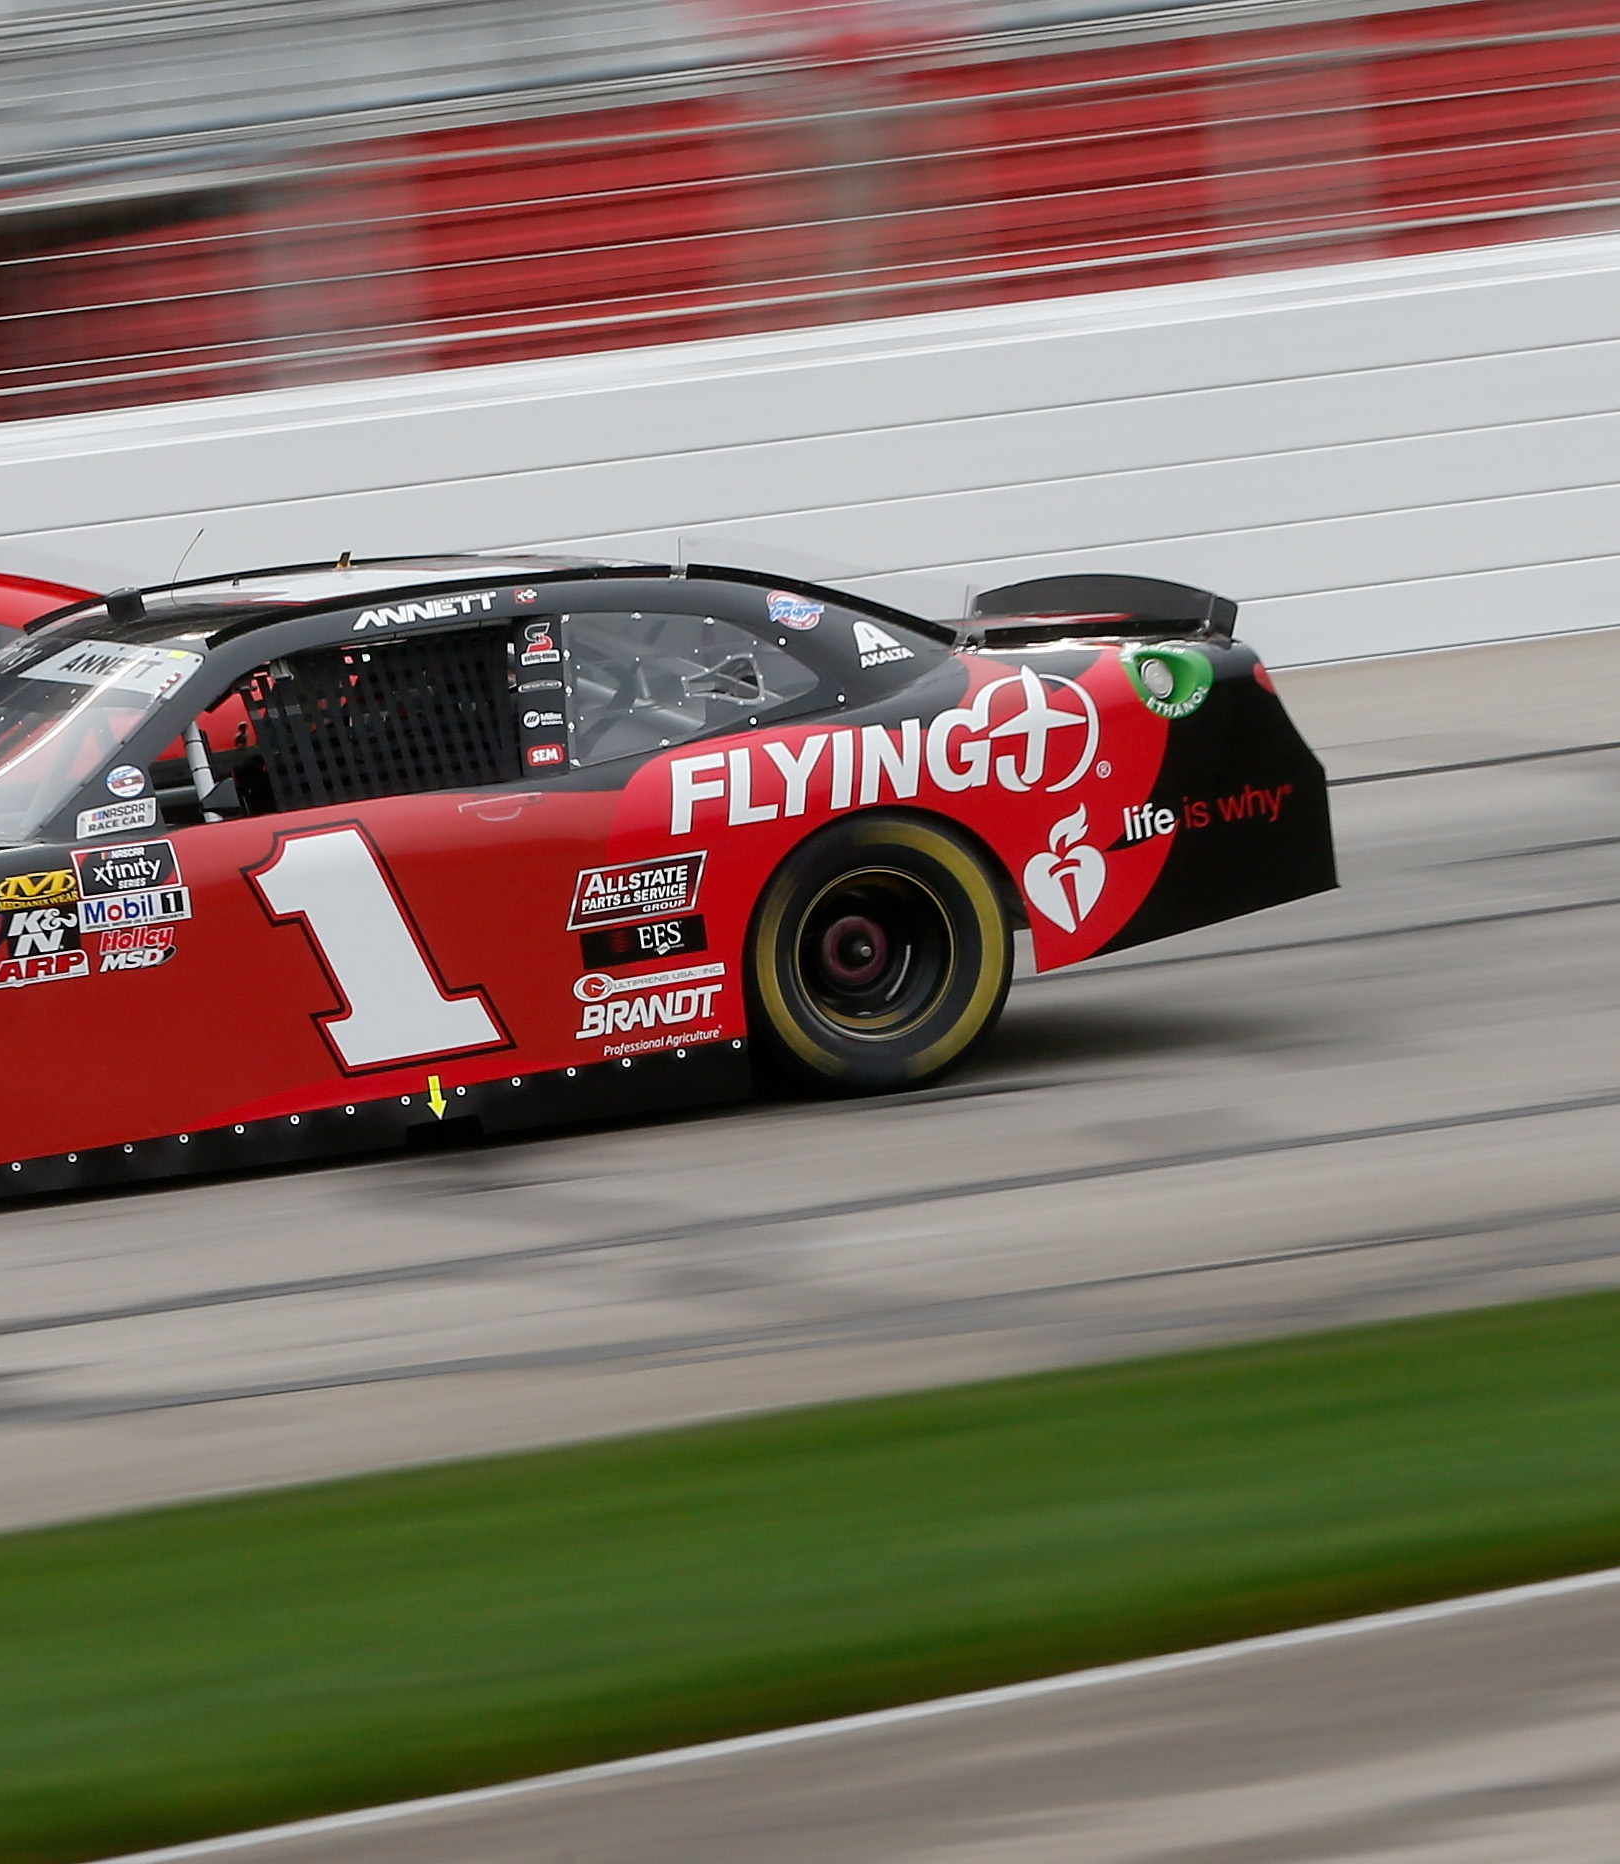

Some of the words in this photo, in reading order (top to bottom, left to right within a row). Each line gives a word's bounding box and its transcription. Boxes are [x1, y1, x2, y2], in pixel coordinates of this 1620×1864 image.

[353, 591, 497, 631] ANNETT
[59, 653, 163, 679] ANNET
[860, 646, 915, 669] AXALTA
[1146, 686, 1210, 717] ETHANOL
[532, 749, 559, 763] SEM
[670, 707, 990, 835] FLYING
[87, 820, 119, 832] RACE
[122, 814, 146, 826] CAR
[102, 802, 146, 819] NASCAR
[1123, 803, 1176, 841] life
[1183, 795, 1211, 829] is
[1217, 784, 1282, 822] why
[111, 847, 145, 859] NASCAR
[92, 857, 161, 886] xfinity
[118, 877, 147, 890] SERIES
[584, 864, 689, 898] ALLSTATE
[84, 894, 154, 925] Mobil
[581, 894, 621, 912] PARTS
[622, 893, 631, 904] &
[633, 882, 687, 904] SERVICE
[642, 899, 686, 913] GROUP
[99, 926, 175, 956] Holley
[249, 825, 507, 1071] 1
[636, 921, 683, 950] EFS
[100, 948, 165, 973] MSD
[575, 984, 723, 1039] BRANDT
[603, 1037, 664, 1057] Professional
[665, 1028, 720, 1048] Agriculture
